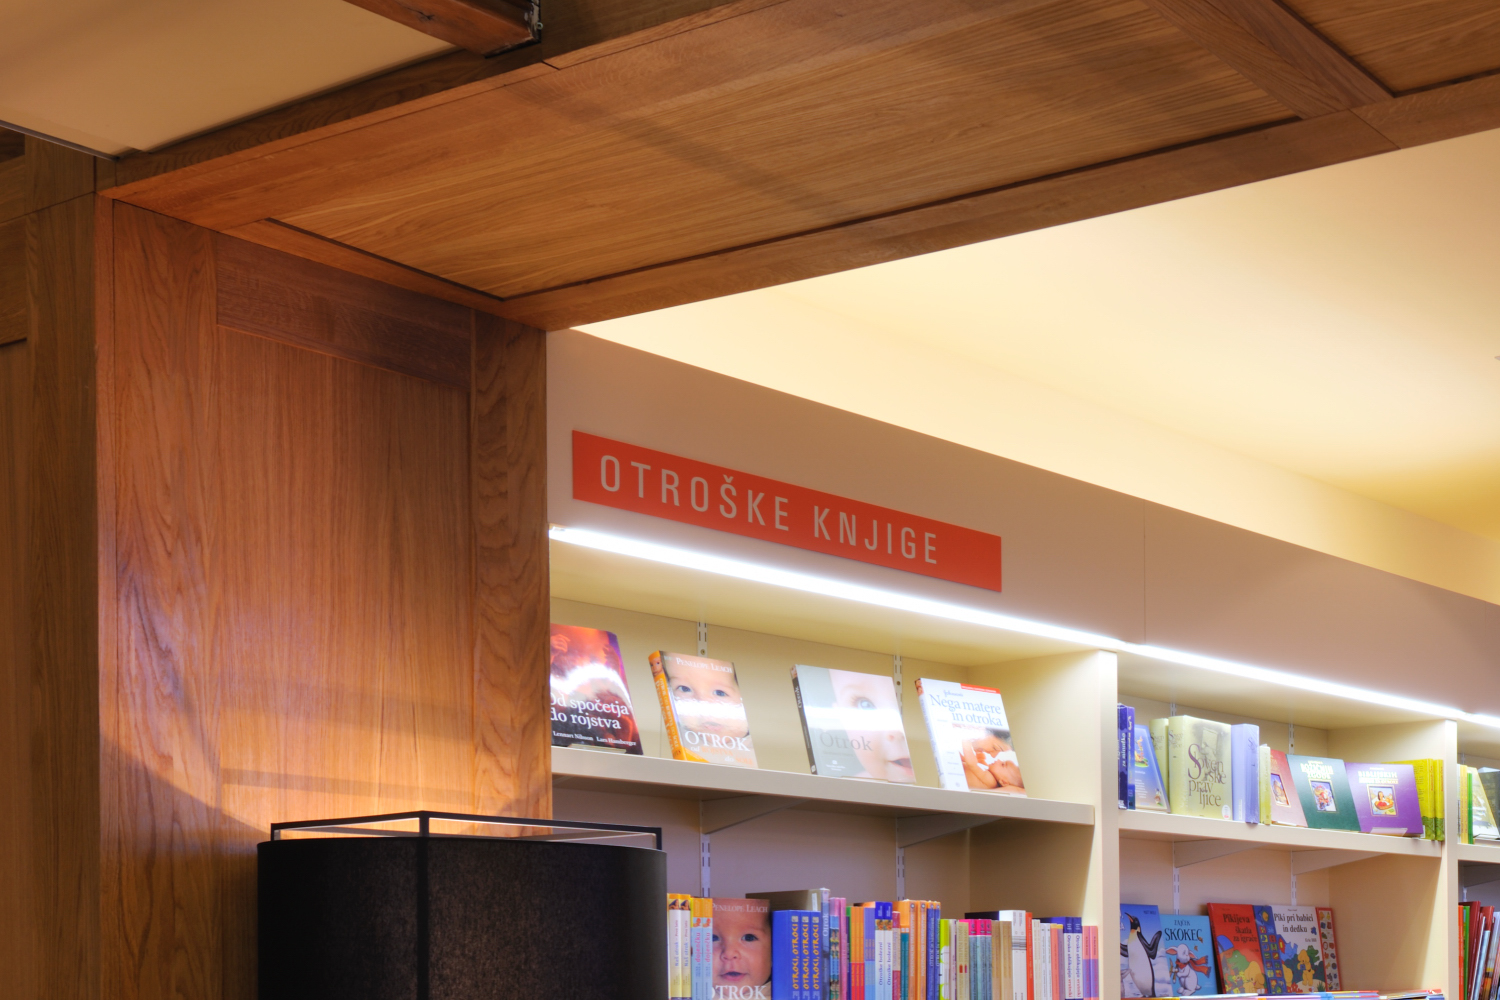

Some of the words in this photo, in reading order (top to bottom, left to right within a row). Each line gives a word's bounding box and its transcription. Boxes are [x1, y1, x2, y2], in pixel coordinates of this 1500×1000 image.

[601, 455, 789, 531] OTROŠKE
[814, 505, 937, 564] KNJIGE
[570, 698, 629, 718] spočetja
[929, 693, 961, 712] Nega
[962, 701, 1001, 715] matere
[570, 712, 621, 730] rojstva
[952, 712, 964, 722] in
[965, 712, 1003, 727] otroka
[684, 730, 751, 752] OTROK
[819, 731, 873, 751] Otrok
[812, 925, 820, 955] OTROCI
[812, 957, 820, 990] OTROCI,
[712, 985, 767, 1000] TROK
